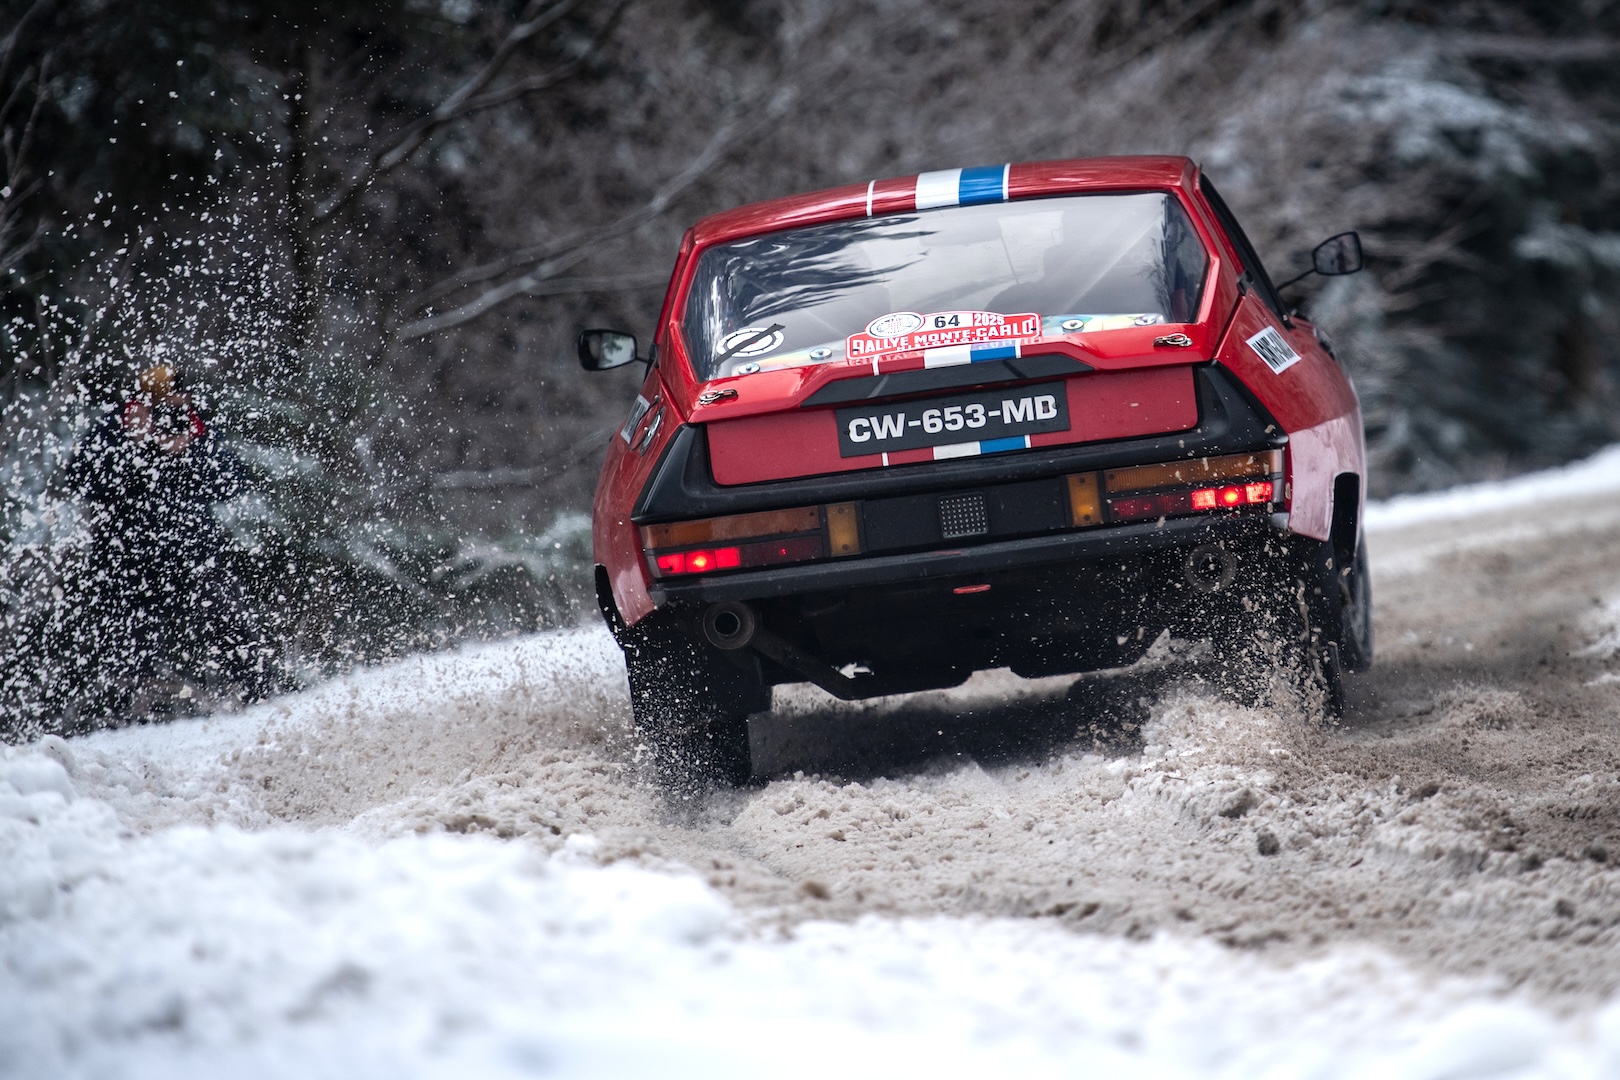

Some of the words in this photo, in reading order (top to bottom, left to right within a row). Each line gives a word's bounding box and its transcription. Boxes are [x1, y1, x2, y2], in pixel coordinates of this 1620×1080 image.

[934, 314, 960, 328] 64
[973, 313, 1005, 326] 2025
[852, 336, 909, 355] RALLYE
[914, 317, 1036, 344] MONTE-CARLO
[849, 394, 1058, 443] CW-653-MD
